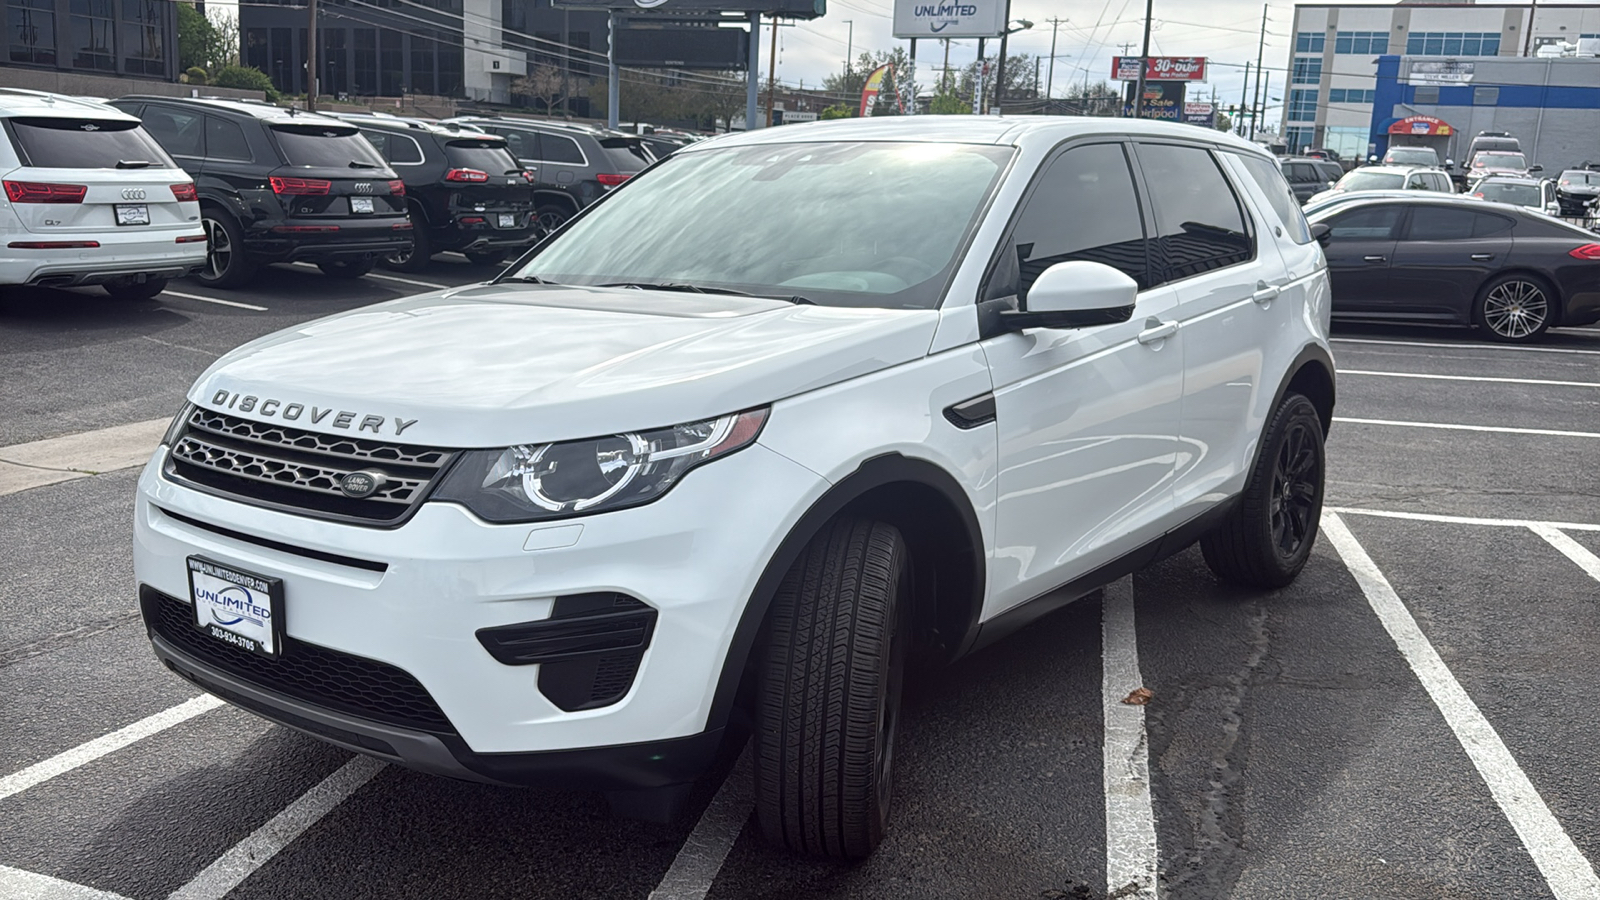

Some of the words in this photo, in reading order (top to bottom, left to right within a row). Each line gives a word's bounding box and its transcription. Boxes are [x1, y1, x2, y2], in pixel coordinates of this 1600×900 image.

[914, 4, 977, 17] UNLIMITED
[1149, 99, 1174, 107] Sale
[1404, 116, 1439, 124] ENTRANCE
[211, 388, 419, 436] DISCOVERY
[196, 587, 271, 619] UNLIMITED
[211, 626, 255, 652] 303-934-3705
